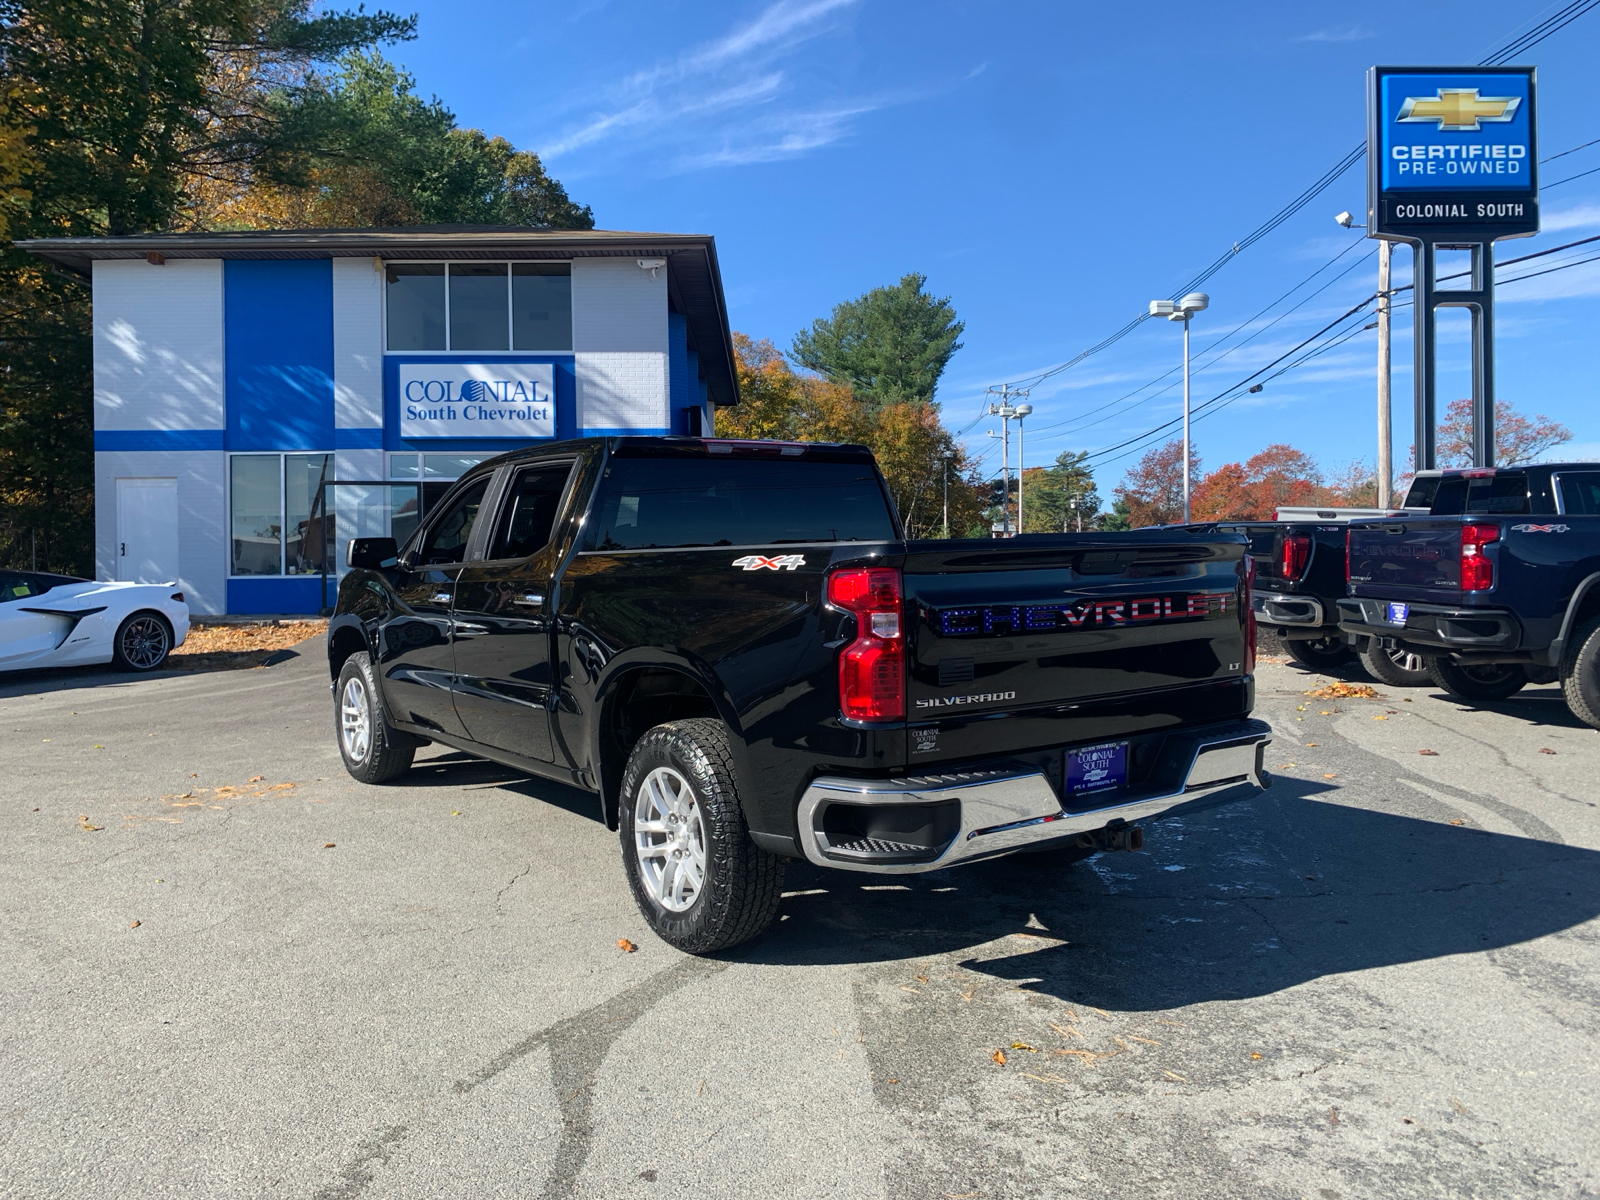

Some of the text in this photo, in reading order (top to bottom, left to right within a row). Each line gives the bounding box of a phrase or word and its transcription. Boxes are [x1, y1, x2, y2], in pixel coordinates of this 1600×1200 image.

[1392, 145, 1526, 159] CERTIFIED
[1399, 161, 1520, 174] PRE-OWNED
[1396, 204, 1524, 218] COLONIAL SOUTH
[405, 379, 549, 402] COLONIAL
[406, 405, 549, 420] South Chevrolet
[942, 592, 1234, 636] CHEVROLET
[1229, 662, 1240, 671] LT
[916, 691, 1016, 708] SILVERADO
[916, 735, 936, 743] SOUTH
[1078, 749, 1115, 763] COLONIAL
[1083, 759, 1109, 771] SOUTH
